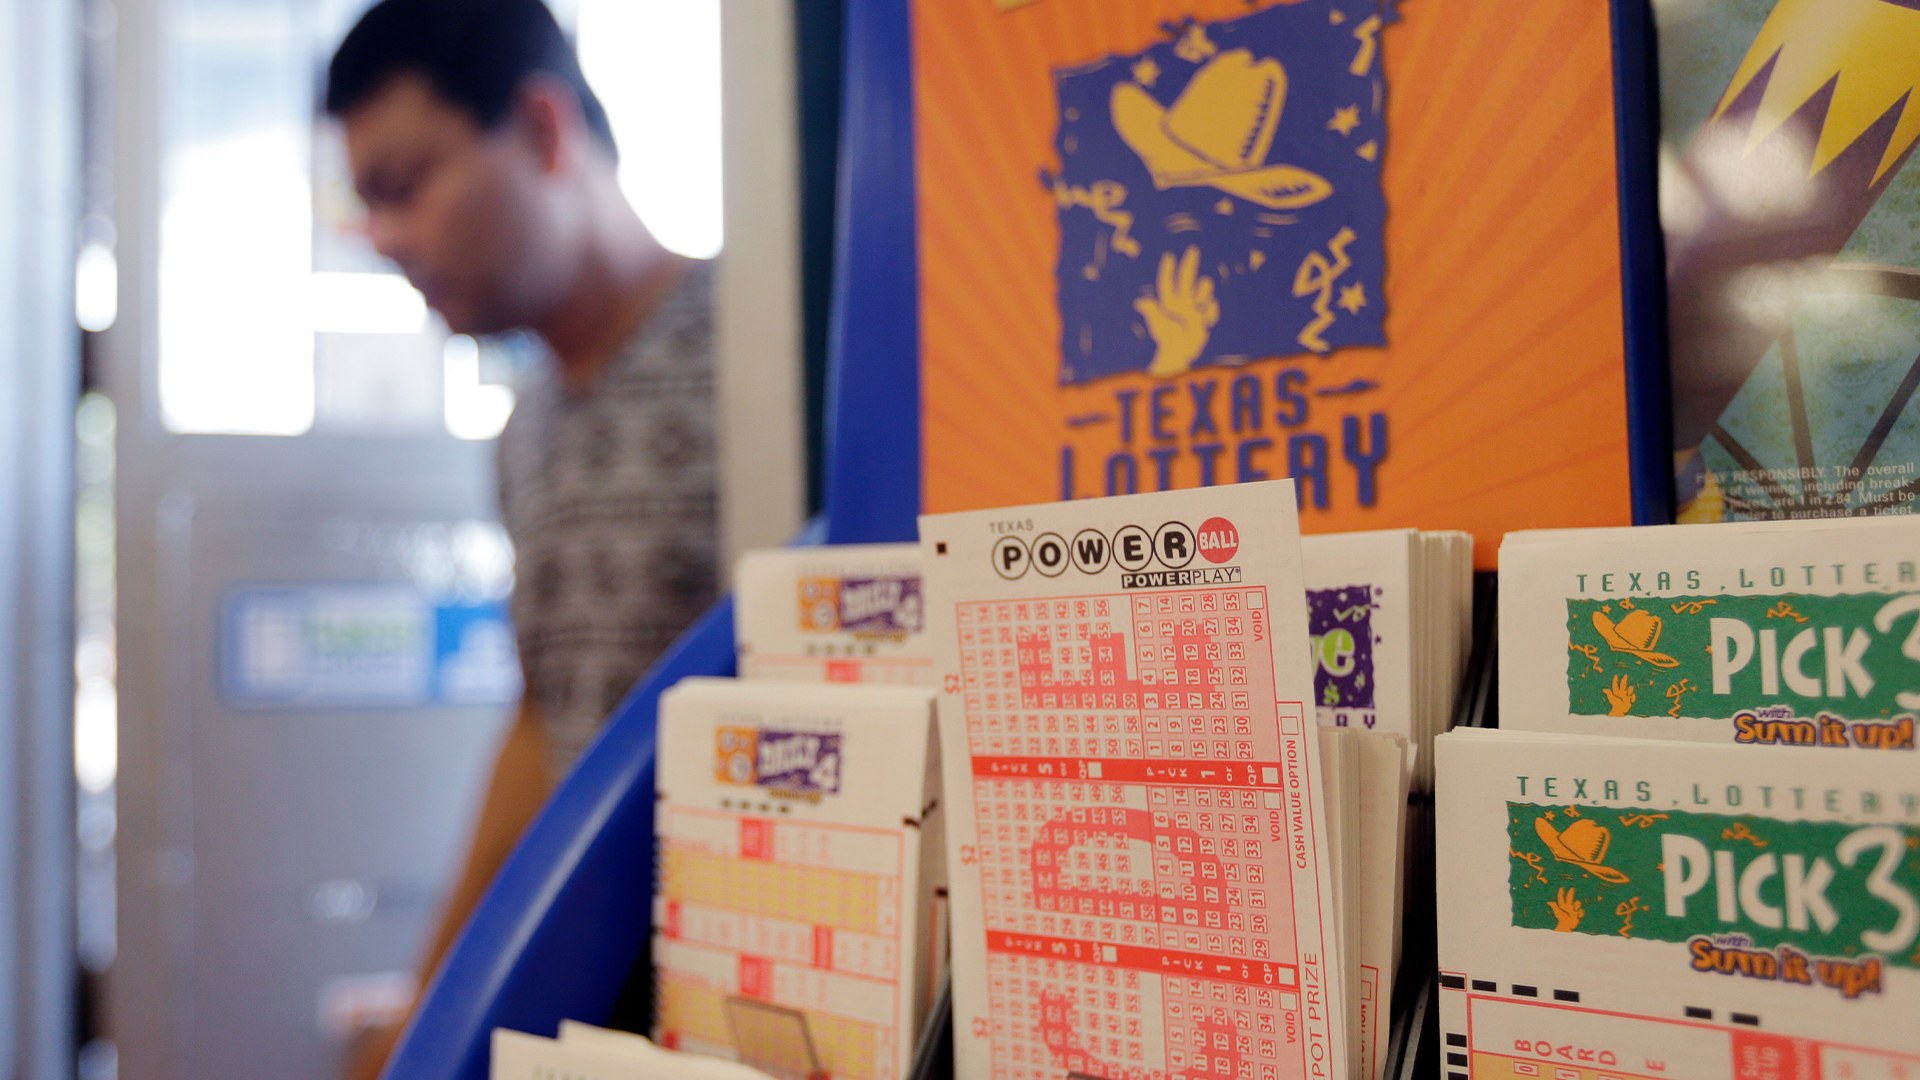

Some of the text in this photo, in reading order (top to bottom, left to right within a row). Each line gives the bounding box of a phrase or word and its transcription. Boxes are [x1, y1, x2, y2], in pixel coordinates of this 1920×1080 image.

[1116, 369, 1309, 444] TEXAS
[1834, 465, 1860, 477] The
[1867, 462, 1914, 476] overall
[1805, 479, 1865, 493] including
[1870, 476, 1914, 489] break-
[1773, 497, 1795, 508] are
[1810, 495, 1821, 505] in
[1859, 491, 1894, 503] Must
[1899, 490, 1915, 501] be
[989, 519, 1033, 533] TEXAS
[1771, 509, 1784, 520] to
[1791, 507, 1852, 520] purchase
[1860, 507, 1867, 517] a
[1576, 569, 1701, 593] TEXAS
[1160, 597, 1170, 610] 14
[1161, 621, 1172, 636] 13
[1252, 611, 1263, 642] VOID
[1163, 646, 1174, 660] 12
[1709, 617, 1876, 698] PICK
[1165, 671, 1176, 684] 11
[1181, 597, 1204, 757] 15 16 17 18 19 20 21
[1203, 595, 1227, 757] 22 23 24 25 26 27 28
[1225, 594, 1251, 758] 29 30 31 32 33 34 35
[1167, 693, 1178, 708] 10
[1757, 706, 1792, 720] with
[1735, 713, 1914, 750] Sum it up!
[1038, 763, 1053, 775] 5
[1147, 765, 1257, 785] PICK 1 or QP
[1175, 789, 1186, 804] 14
[1517, 776, 1653, 802] TEXAS
[1287, 740, 1307, 869] CASH VALUE OPTION
[1177, 813, 1189, 828] 13
[1270, 811, 1280, 842] VOID
[1179, 838, 1190, 852] 12
[1181, 863, 1192, 876] 11
[1198, 791, 1220, 950] 15 16 17 18 19 20 21
[1219, 791, 1244, 953] 22 23 24 25 26 27 28
[1242, 792, 1267, 956] 29 30 31 32 33 34 35
[1183, 884, 1194, 900] 10
[1661, 826, 1920, 952] PICK 3
[1162, 956, 1273, 985] PICK 1 or QP
[1690, 938, 1882, 999] Sum it up!
[1304, 953, 1321, 1020] PRIZE
[1258, 990, 1273, 1055] 33 34 35
[1285, 1012, 1296, 1043] VOID
[1515, 1039, 1617, 1066] BOARD
